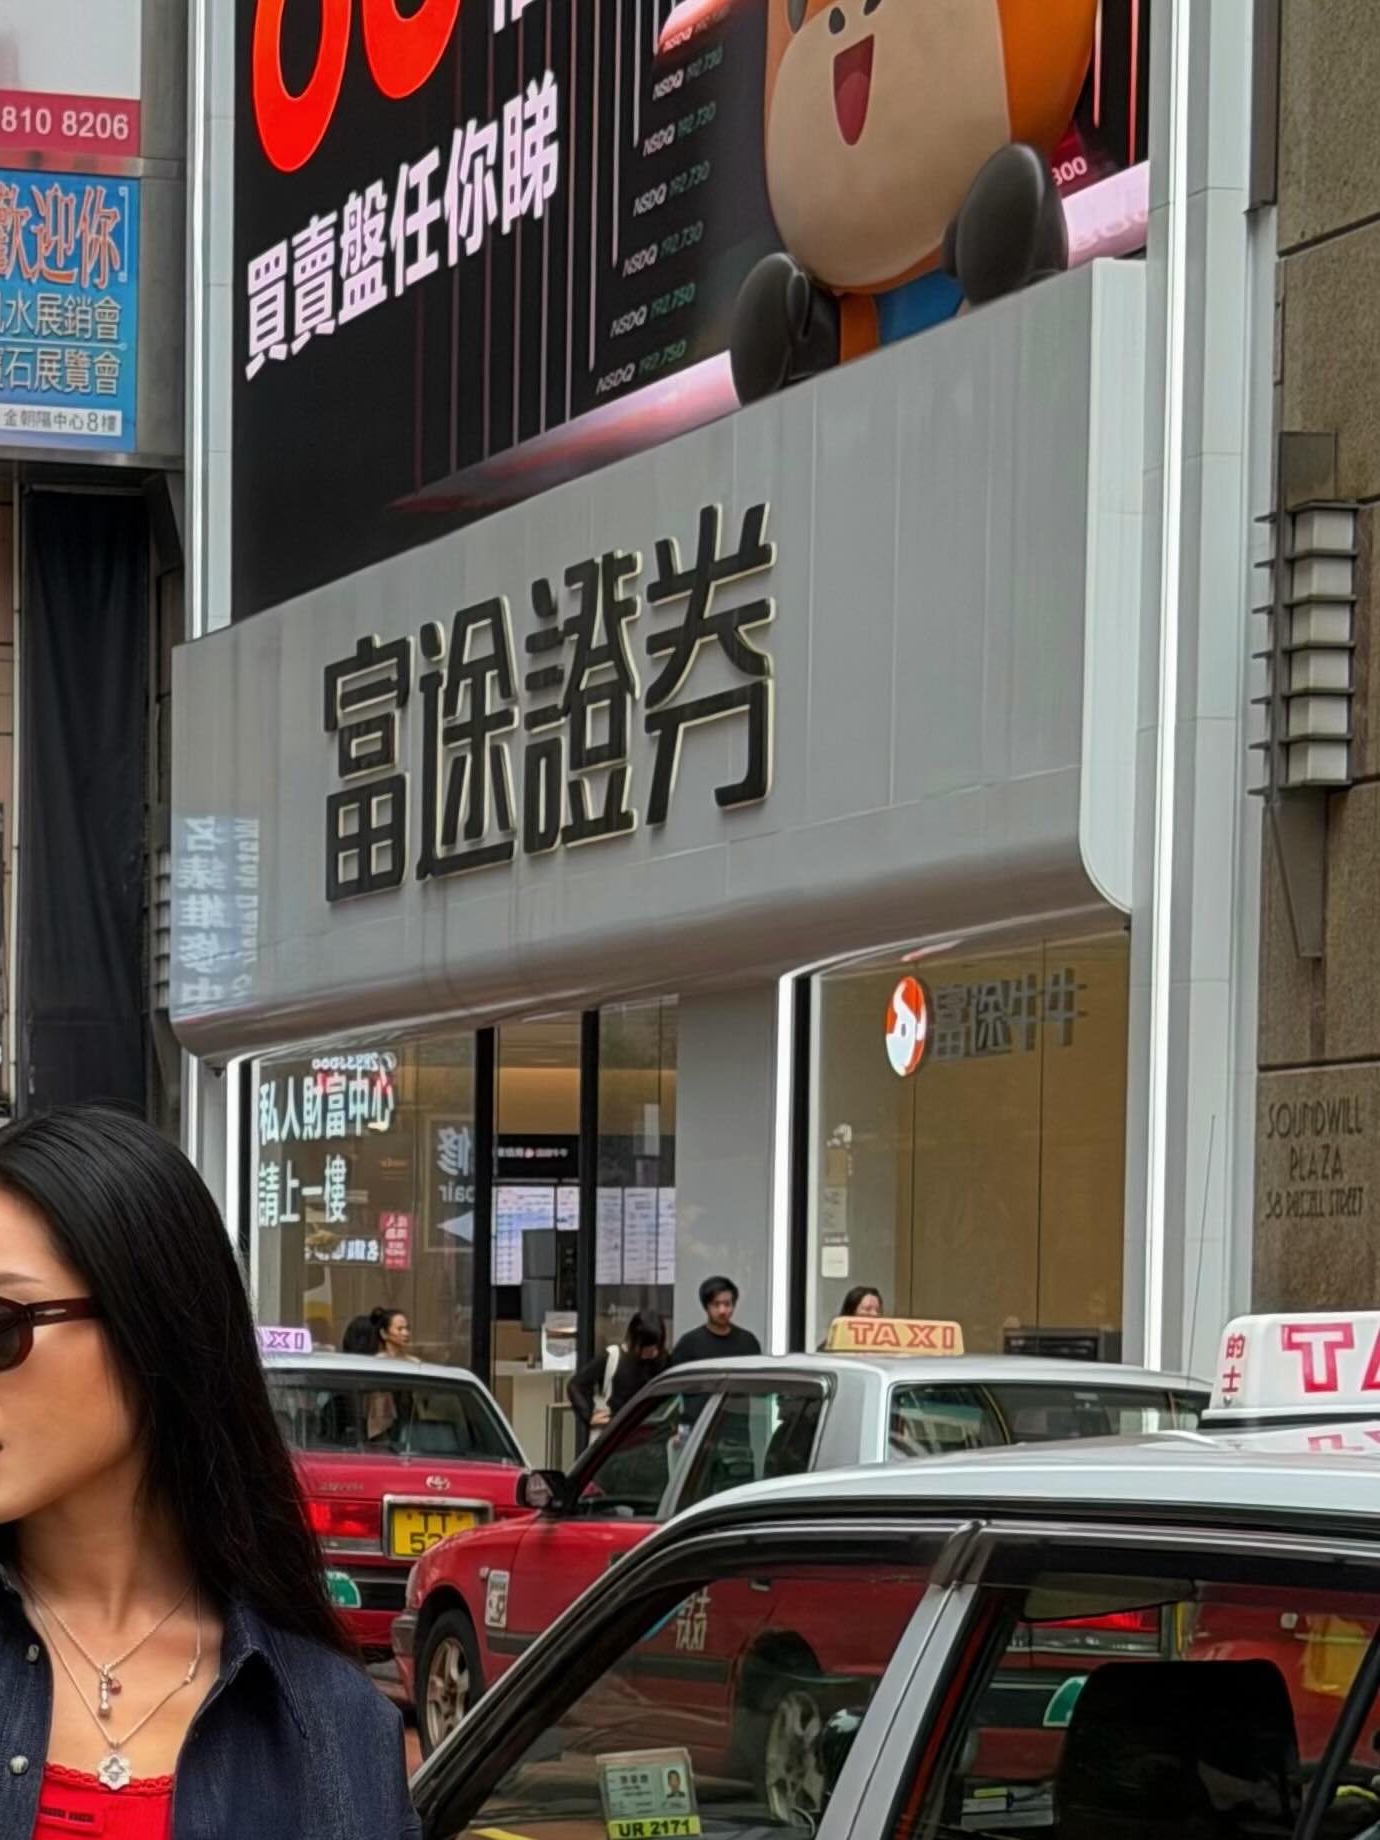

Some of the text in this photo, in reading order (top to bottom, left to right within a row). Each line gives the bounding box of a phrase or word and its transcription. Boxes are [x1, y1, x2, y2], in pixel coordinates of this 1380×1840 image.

[652, 69, 684, 100] NSDQ
[61, 110, 131, 141] 8206
[642, 123, 676, 157] NSDQ
[633, 182, 667, 217] NSDQ
[245, 69, 559, 382] 買賣盤任你睇
[622, 244, 657, 278] NSDQ
[610, 305, 647, 338] NSDQ
[596, 363, 635, 396] NSDQ
[258, 1067, 395, 1147] 私人財富中心
[1267, 1094, 1363, 1139] SOUNDWILL
[1289, 1143, 1345, 1182] PLAZA
[258, 1153, 348, 1227] 請上一樓
[849, 1321, 956, 1350] TAXI
[1222, 1332, 1246, 1393] 的士
[418, 1512, 452, 1534] TT
[619, 1819, 689, 1837] UR 2171
